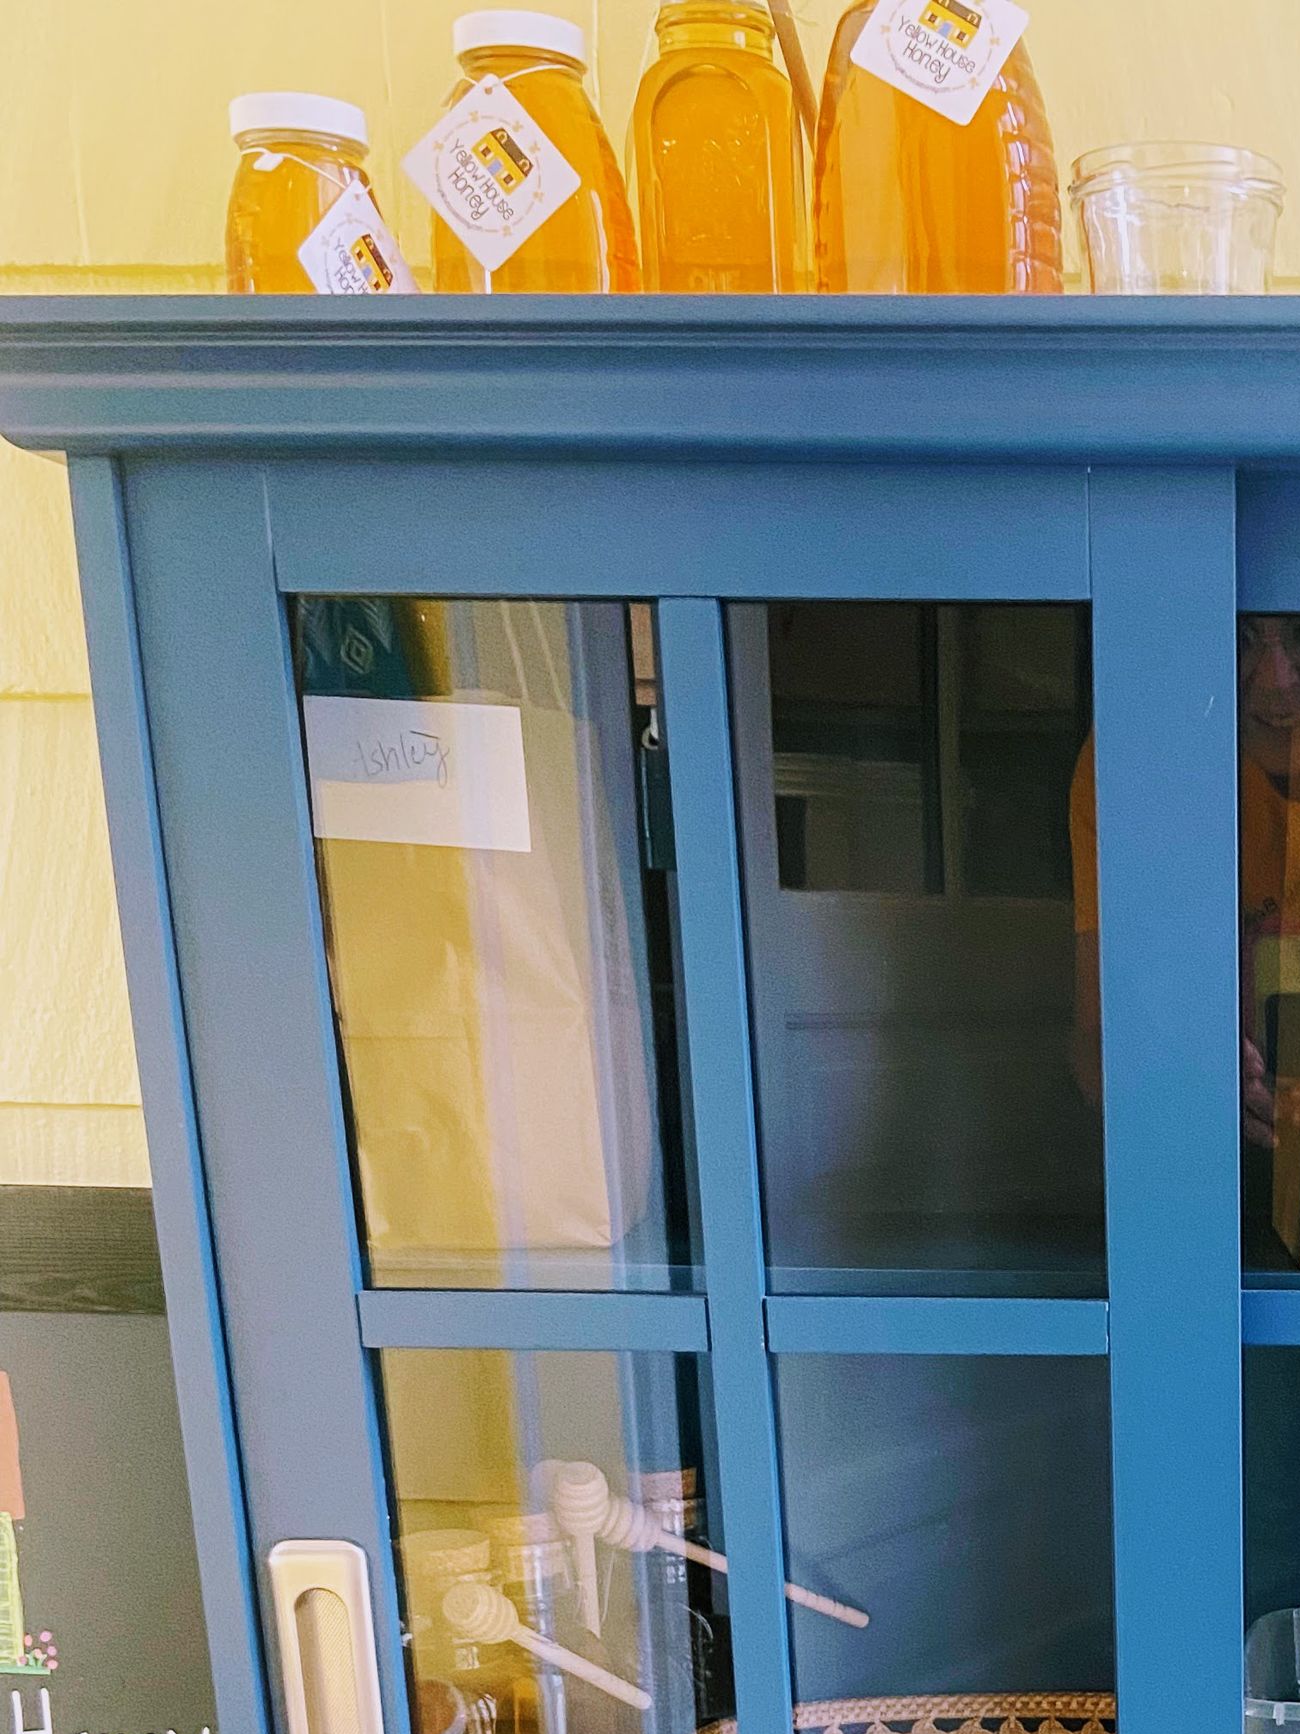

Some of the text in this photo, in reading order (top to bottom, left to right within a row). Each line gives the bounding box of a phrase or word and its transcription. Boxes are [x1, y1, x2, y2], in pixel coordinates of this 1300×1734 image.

[898, 15, 975, 73] Yellow House
[903, 40, 950, 84] Honey
[448, 167, 489, 220] Honey
[450, 138, 485, 181] Yellow
[480, 178, 513, 220] House
[334, 237, 361, 283] Yellow
